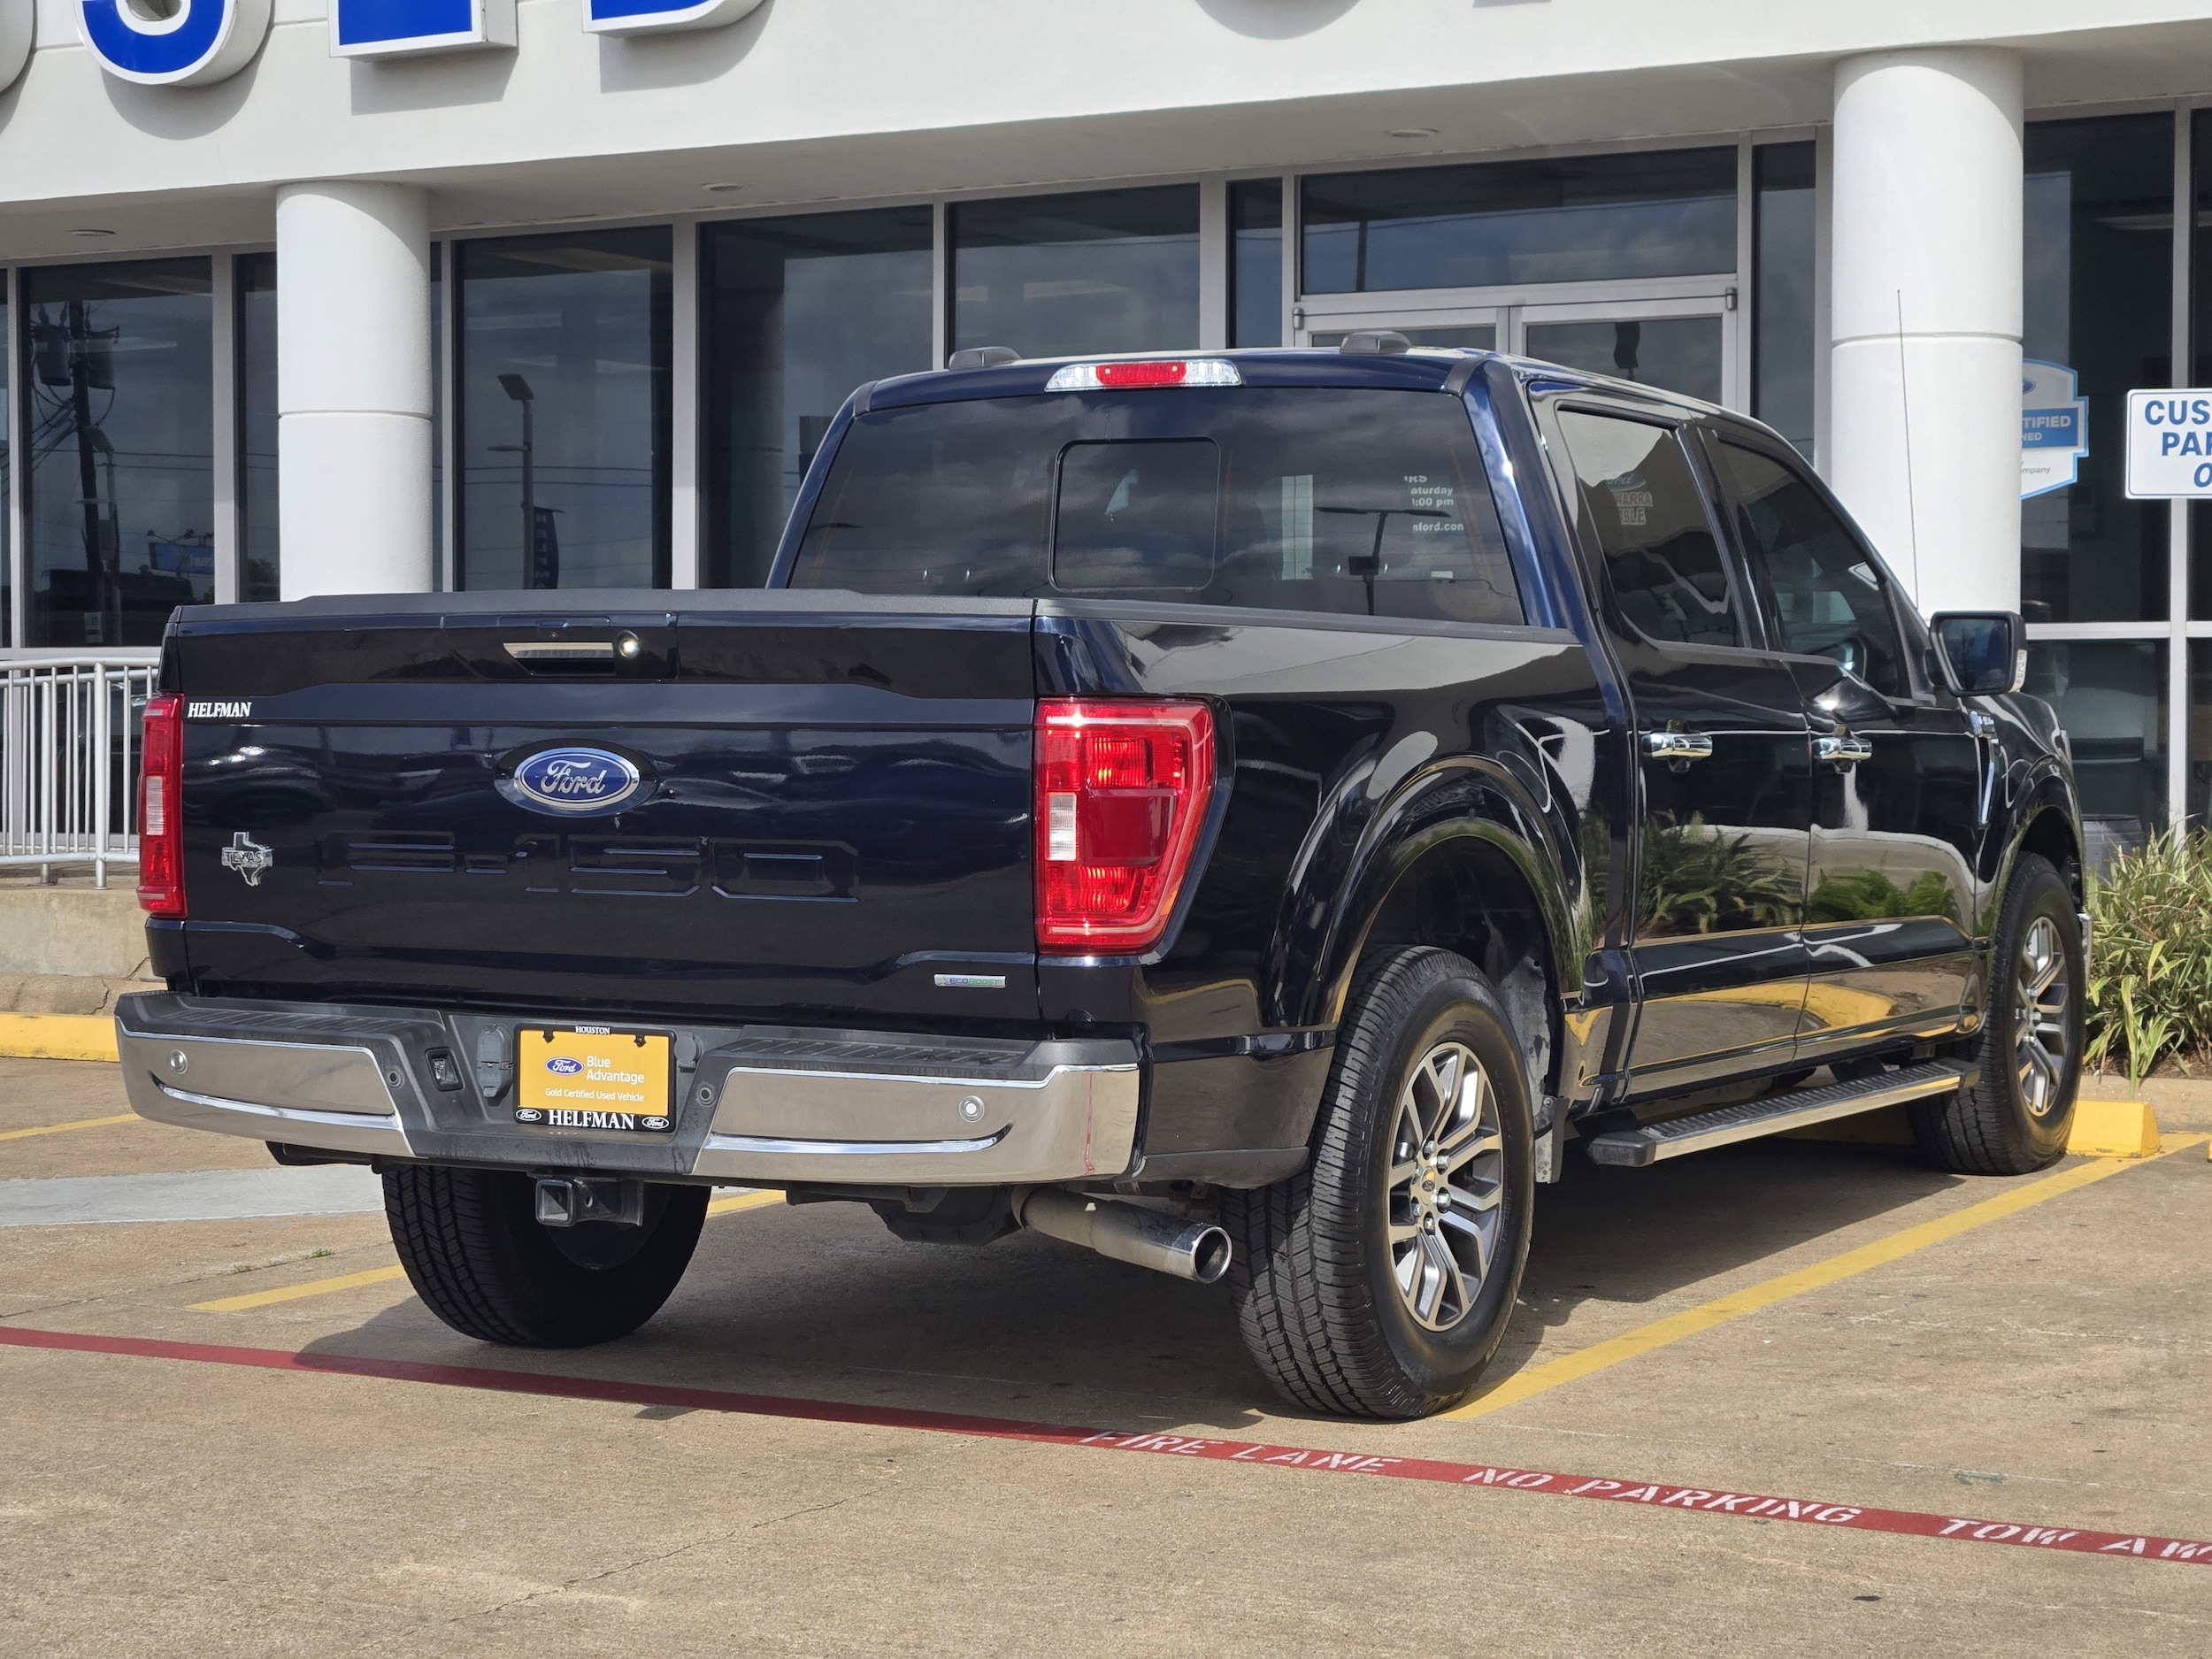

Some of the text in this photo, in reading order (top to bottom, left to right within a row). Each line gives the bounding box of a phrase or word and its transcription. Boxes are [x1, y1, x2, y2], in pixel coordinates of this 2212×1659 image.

[2022, 466, 2051, 475] mpany
[1409, 486, 1454, 495] aturday
[1436, 498, 1455, 508] pm
[187, 702, 252, 718] HELFMAN
[541, 759, 608, 795] Ford
[224, 851, 263, 864] TEXAS
[575, 1025, 611, 1034] HOUSTON
[552, 1056, 611, 1073] Ford Blue
[586, 1071, 644, 1086] Advantage
[545, 1088, 644, 1102] Gold Certified Used Vehicle
[548, 1109, 636, 1130] HELFMAN
[1079, 1430, 2212, 1561] FIRE LANE NO PARKING TOW AW
